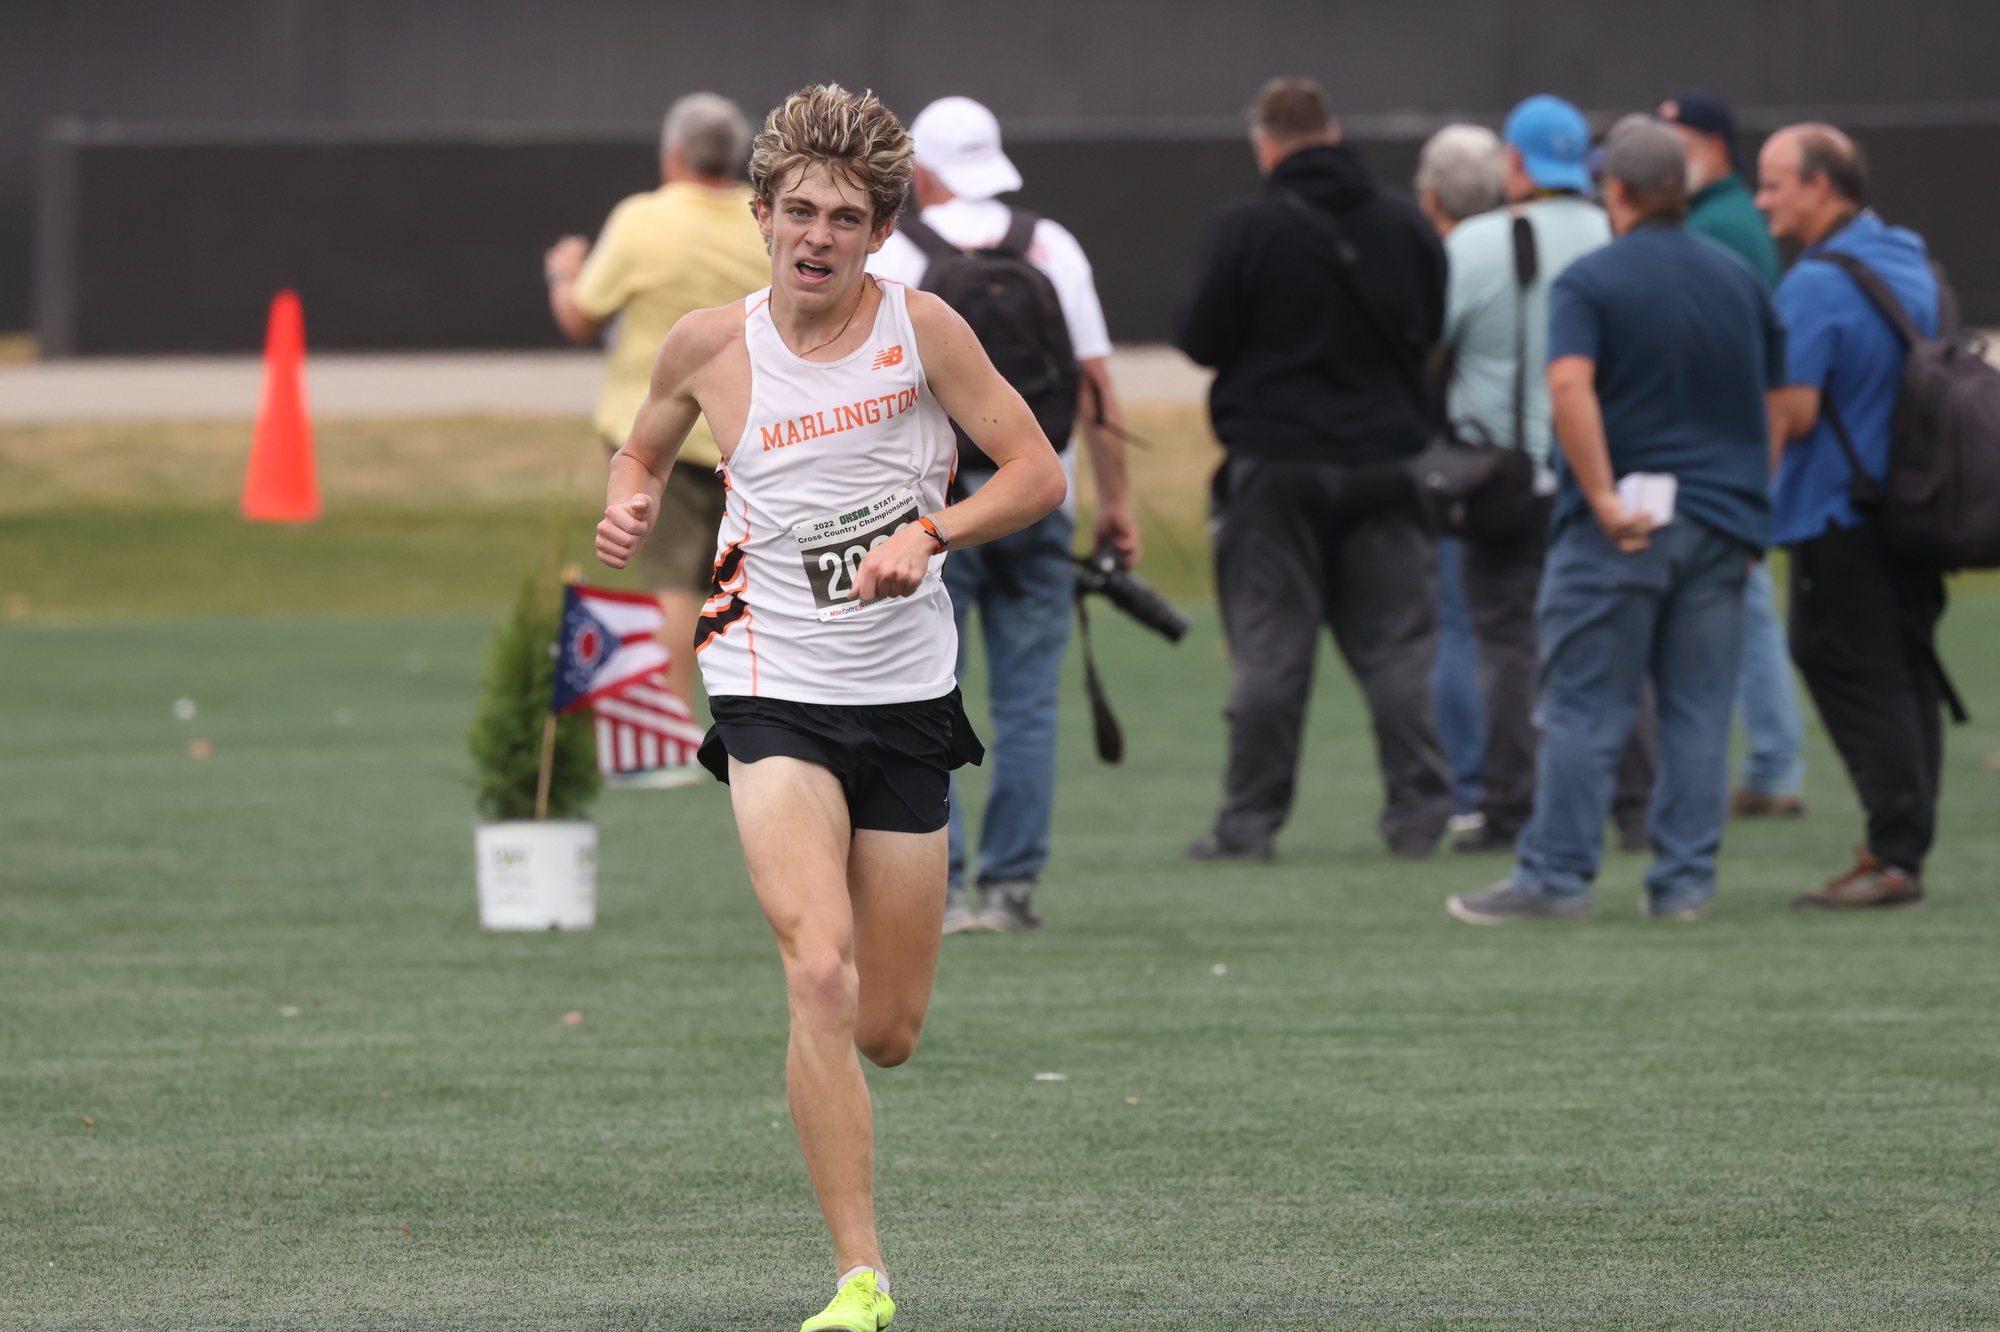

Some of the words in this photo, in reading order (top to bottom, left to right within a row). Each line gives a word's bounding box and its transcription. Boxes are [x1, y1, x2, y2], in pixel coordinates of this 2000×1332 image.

[798, 534, 822, 544] Cross
[824, 525, 857, 538] Country
[859, 495, 914, 527] Championships
[813, 520, 835, 531] 2022
[839, 506, 871, 525] OHSAA
[873, 494, 897, 511] STATE
